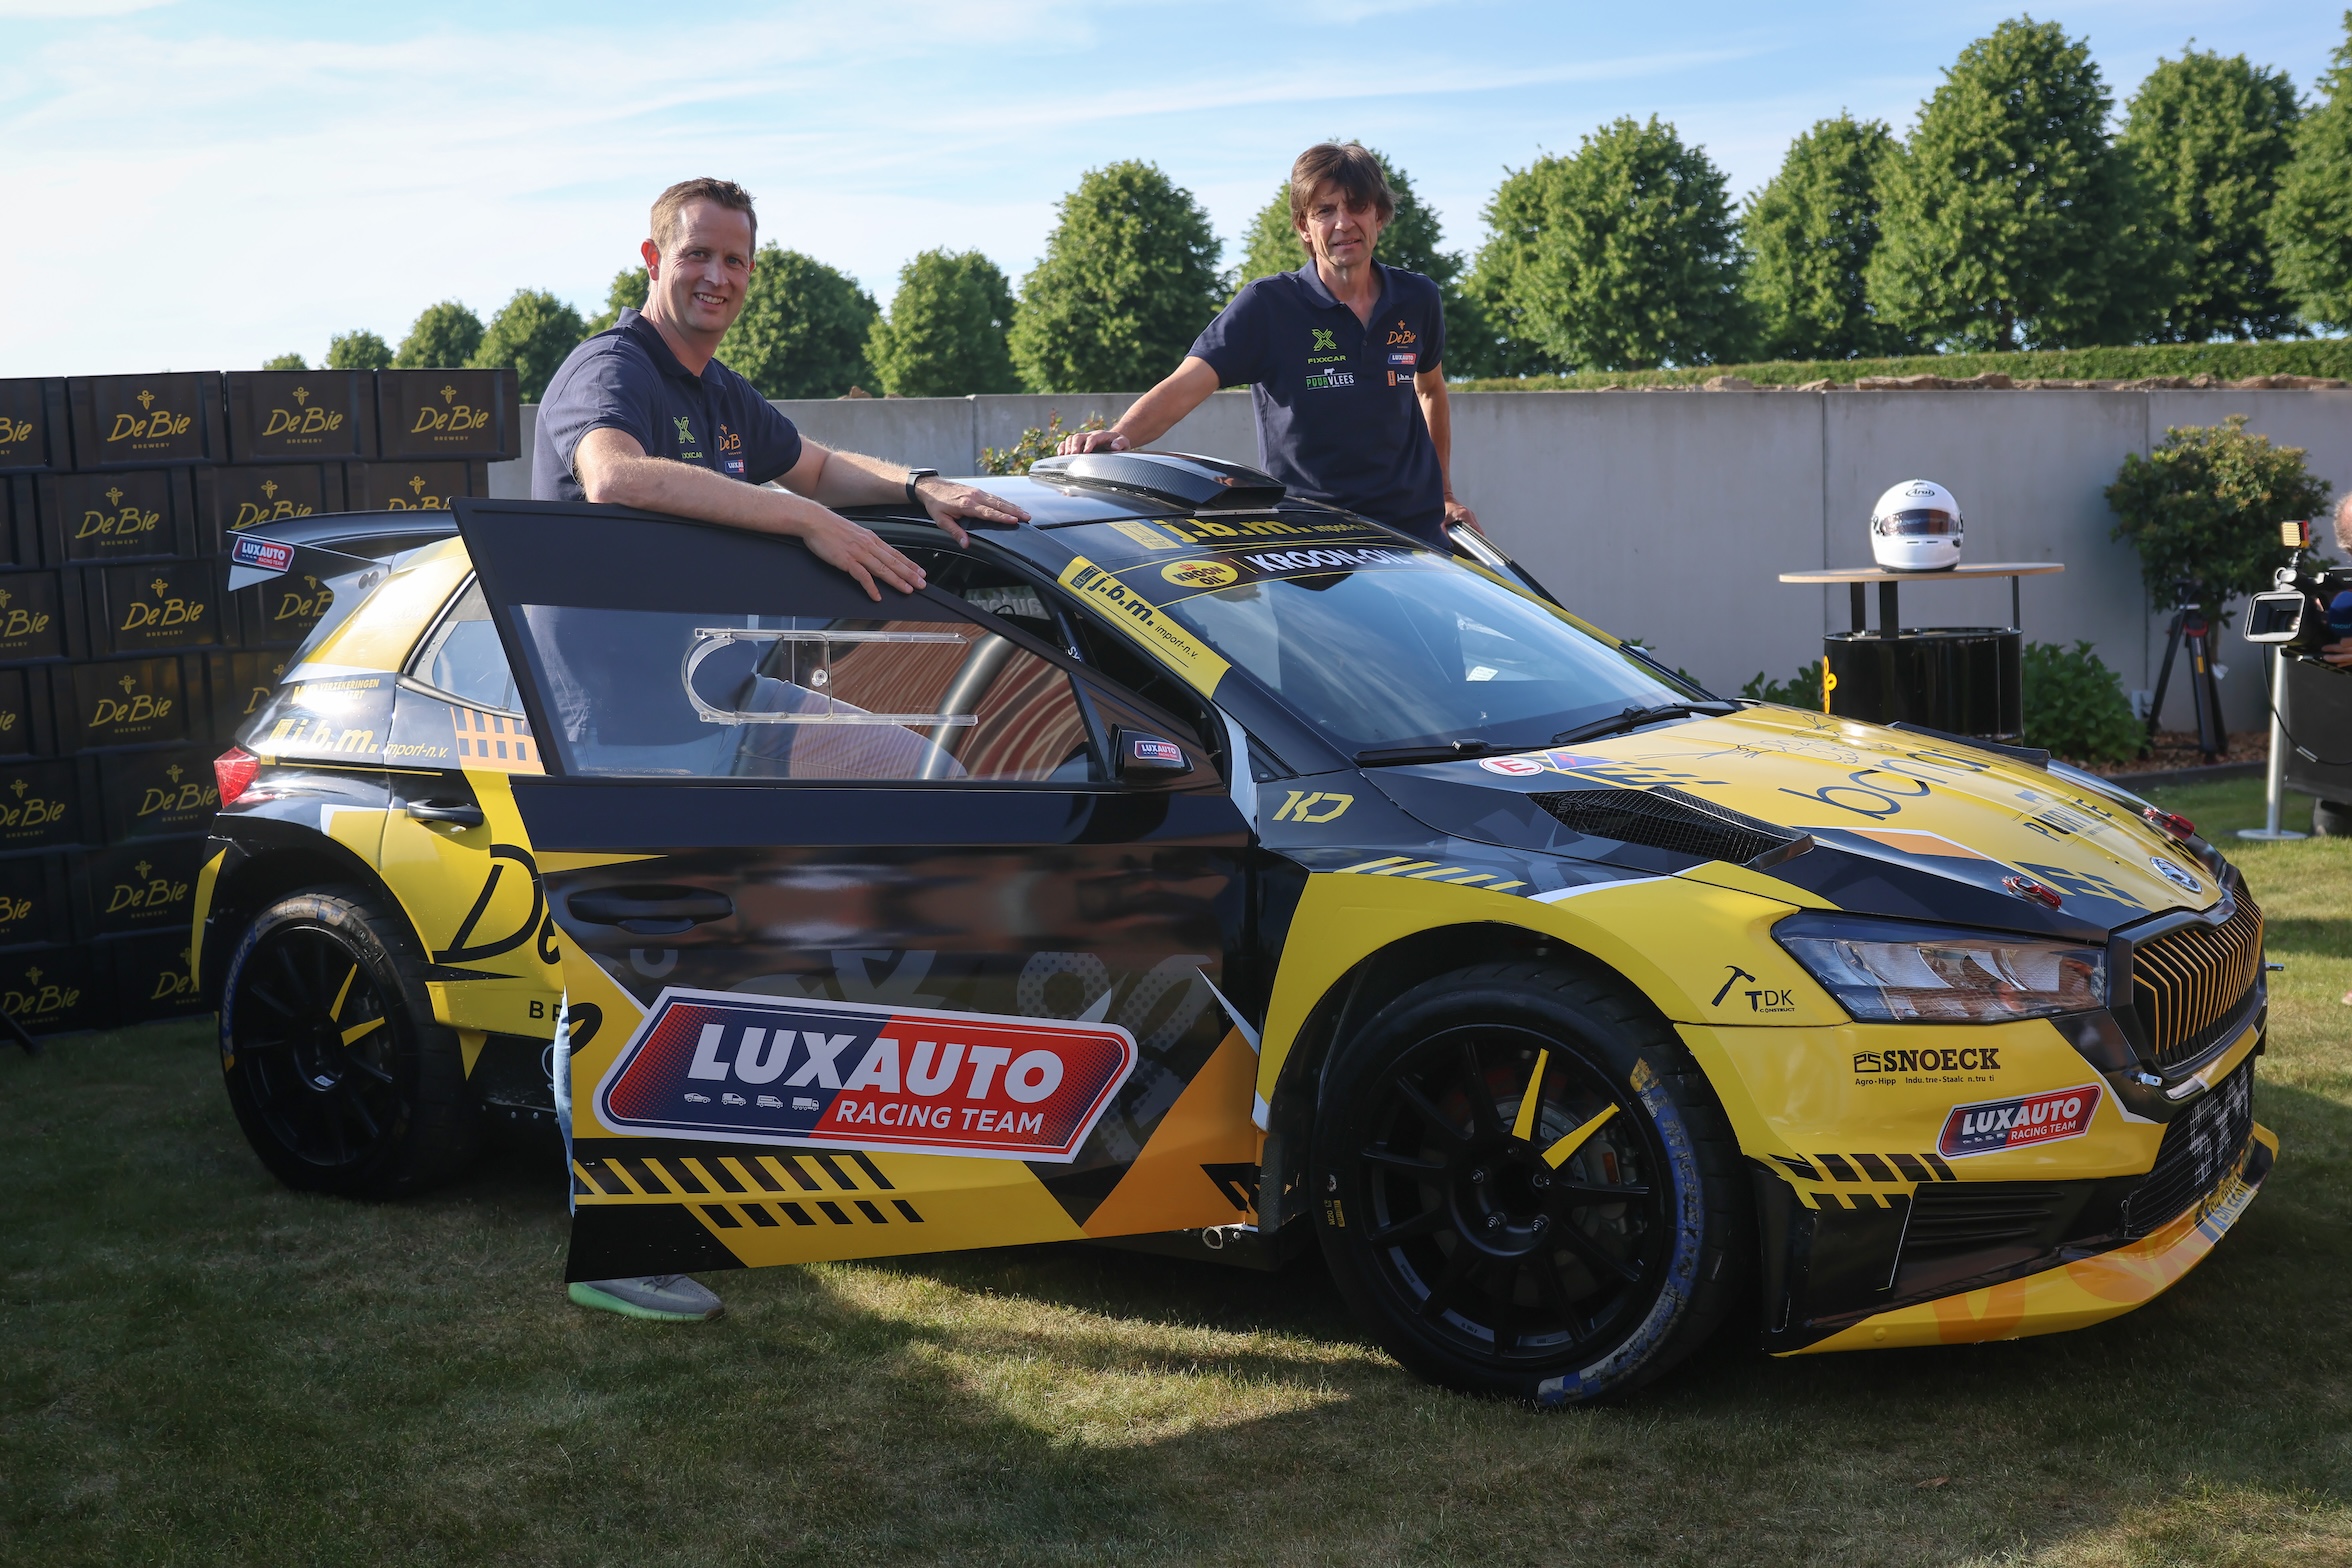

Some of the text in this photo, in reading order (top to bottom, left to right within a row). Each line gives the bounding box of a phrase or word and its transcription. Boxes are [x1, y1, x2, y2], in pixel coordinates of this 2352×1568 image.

[1308, 355, 1347, 364] FIXXCAR
[241, 542, 286, 560] LUXAUTO
[258, 557, 284, 567] RACING TEAM
[1172, 566, 1227, 582] KROON
[1199, 576, 1228, 586] OIL
[1087, 575, 1199, 660] j.b.m. import-n.v.
[1141, 744, 1177, 755] LUXAUTO
[1745, 989, 1795, 1013] TDK
[686, 1023, 1064, 1103] LUXAUTO
[1883, 1048, 2001, 1072] SNOECK
[835, 1099, 1044, 1135] RACING TEAM
[1962, 1097, 2082, 1136] LUXAUTO
[2011, 1120, 2077, 1141] RACING TEAM
